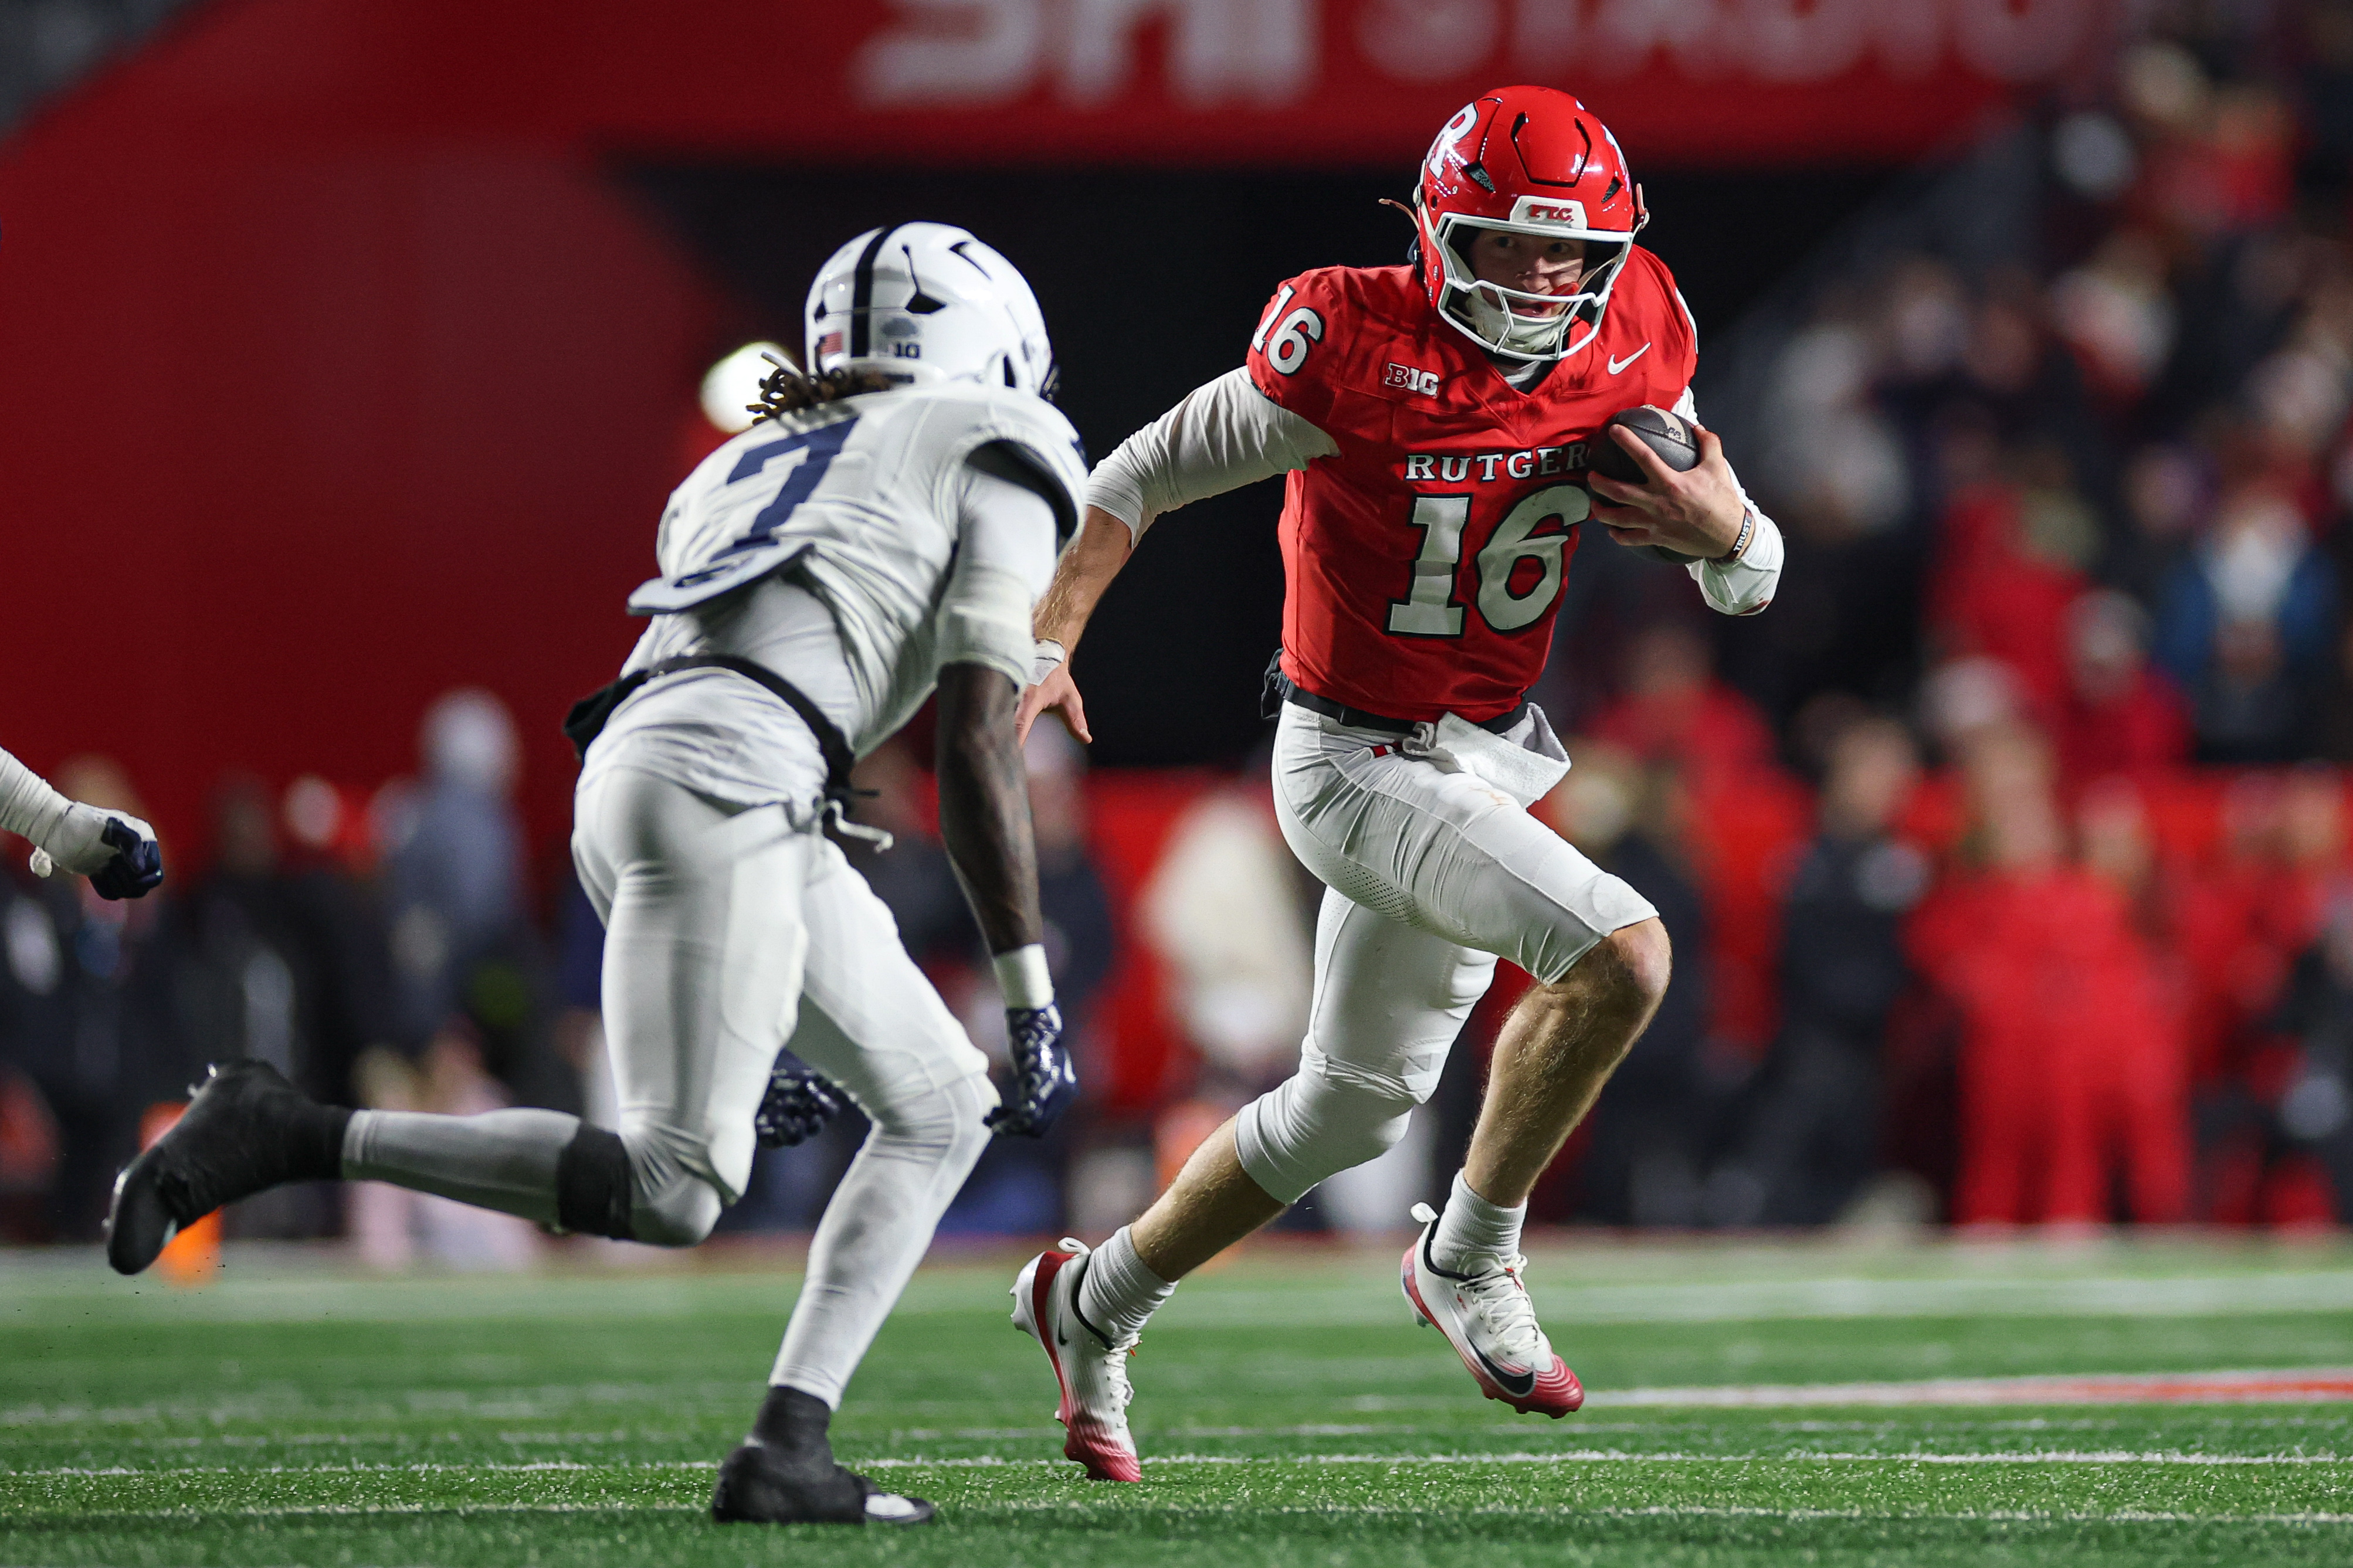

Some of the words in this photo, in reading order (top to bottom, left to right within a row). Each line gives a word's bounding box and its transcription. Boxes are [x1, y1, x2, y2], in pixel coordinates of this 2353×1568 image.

[1426, 102, 1479, 179] R
[1252, 284, 1324, 375] 16
[706, 418, 860, 564] 7
[1406, 443, 1591, 481] RUTGER
[1389, 484, 1591, 636] 16
[1733, 519, 1751, 551] TRUST
